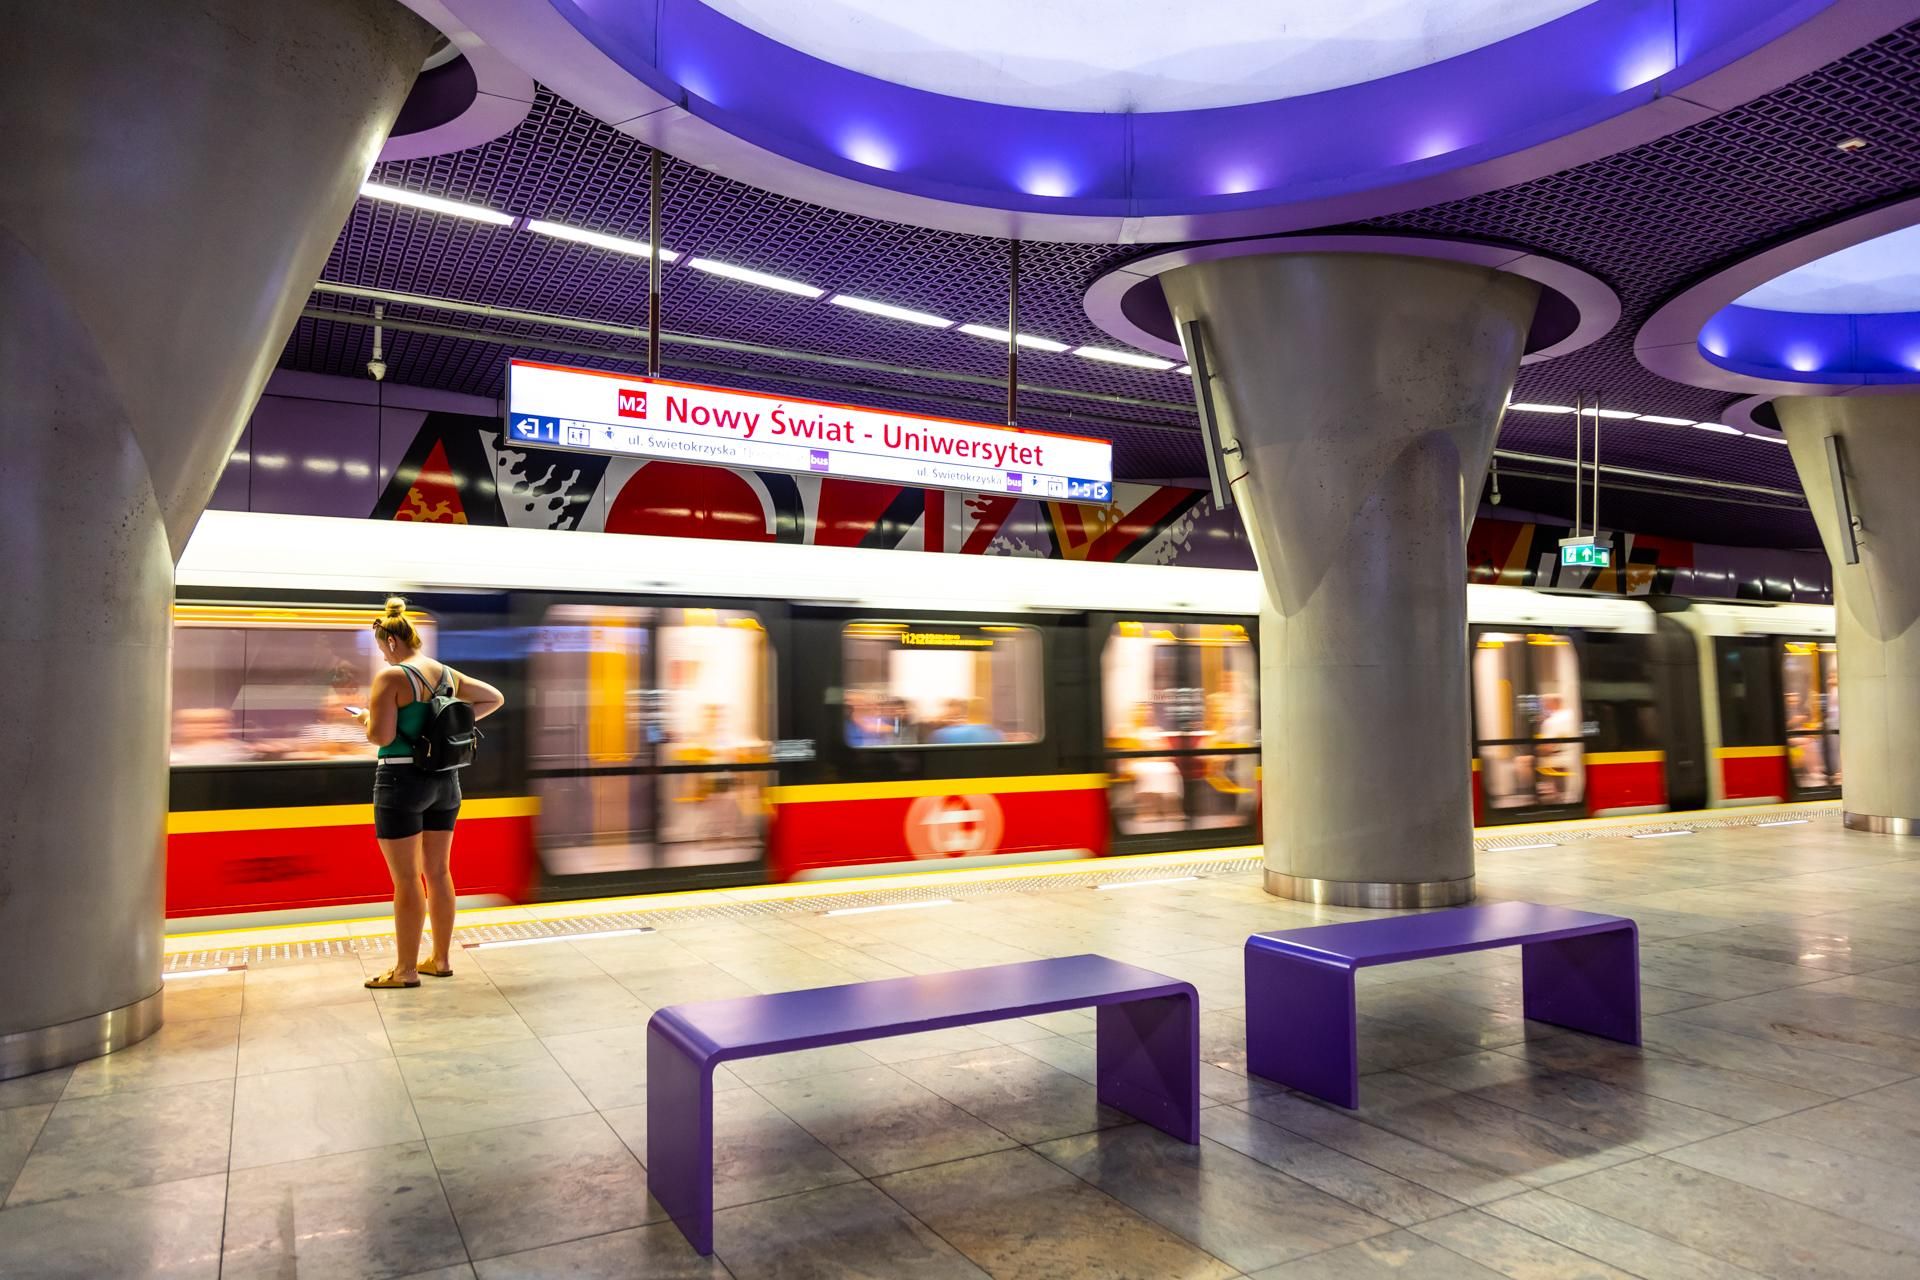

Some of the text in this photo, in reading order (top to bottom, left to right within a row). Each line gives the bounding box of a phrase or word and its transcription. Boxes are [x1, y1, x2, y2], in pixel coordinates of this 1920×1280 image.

[619, 394, 646, 414] M2
[545, 422, 554, 440] 1
[666, 396, 761, 438] Nowy
[771, 404, 855, 444] Świat
[883, 424, 1044, 468] Uniwersytet
[628, 435, 644, 447] ul.
[810, 453, 829, 469] bus
[1007, 477, 1022, 488] bus
[1071, 481, 1091, 497] 2-5
